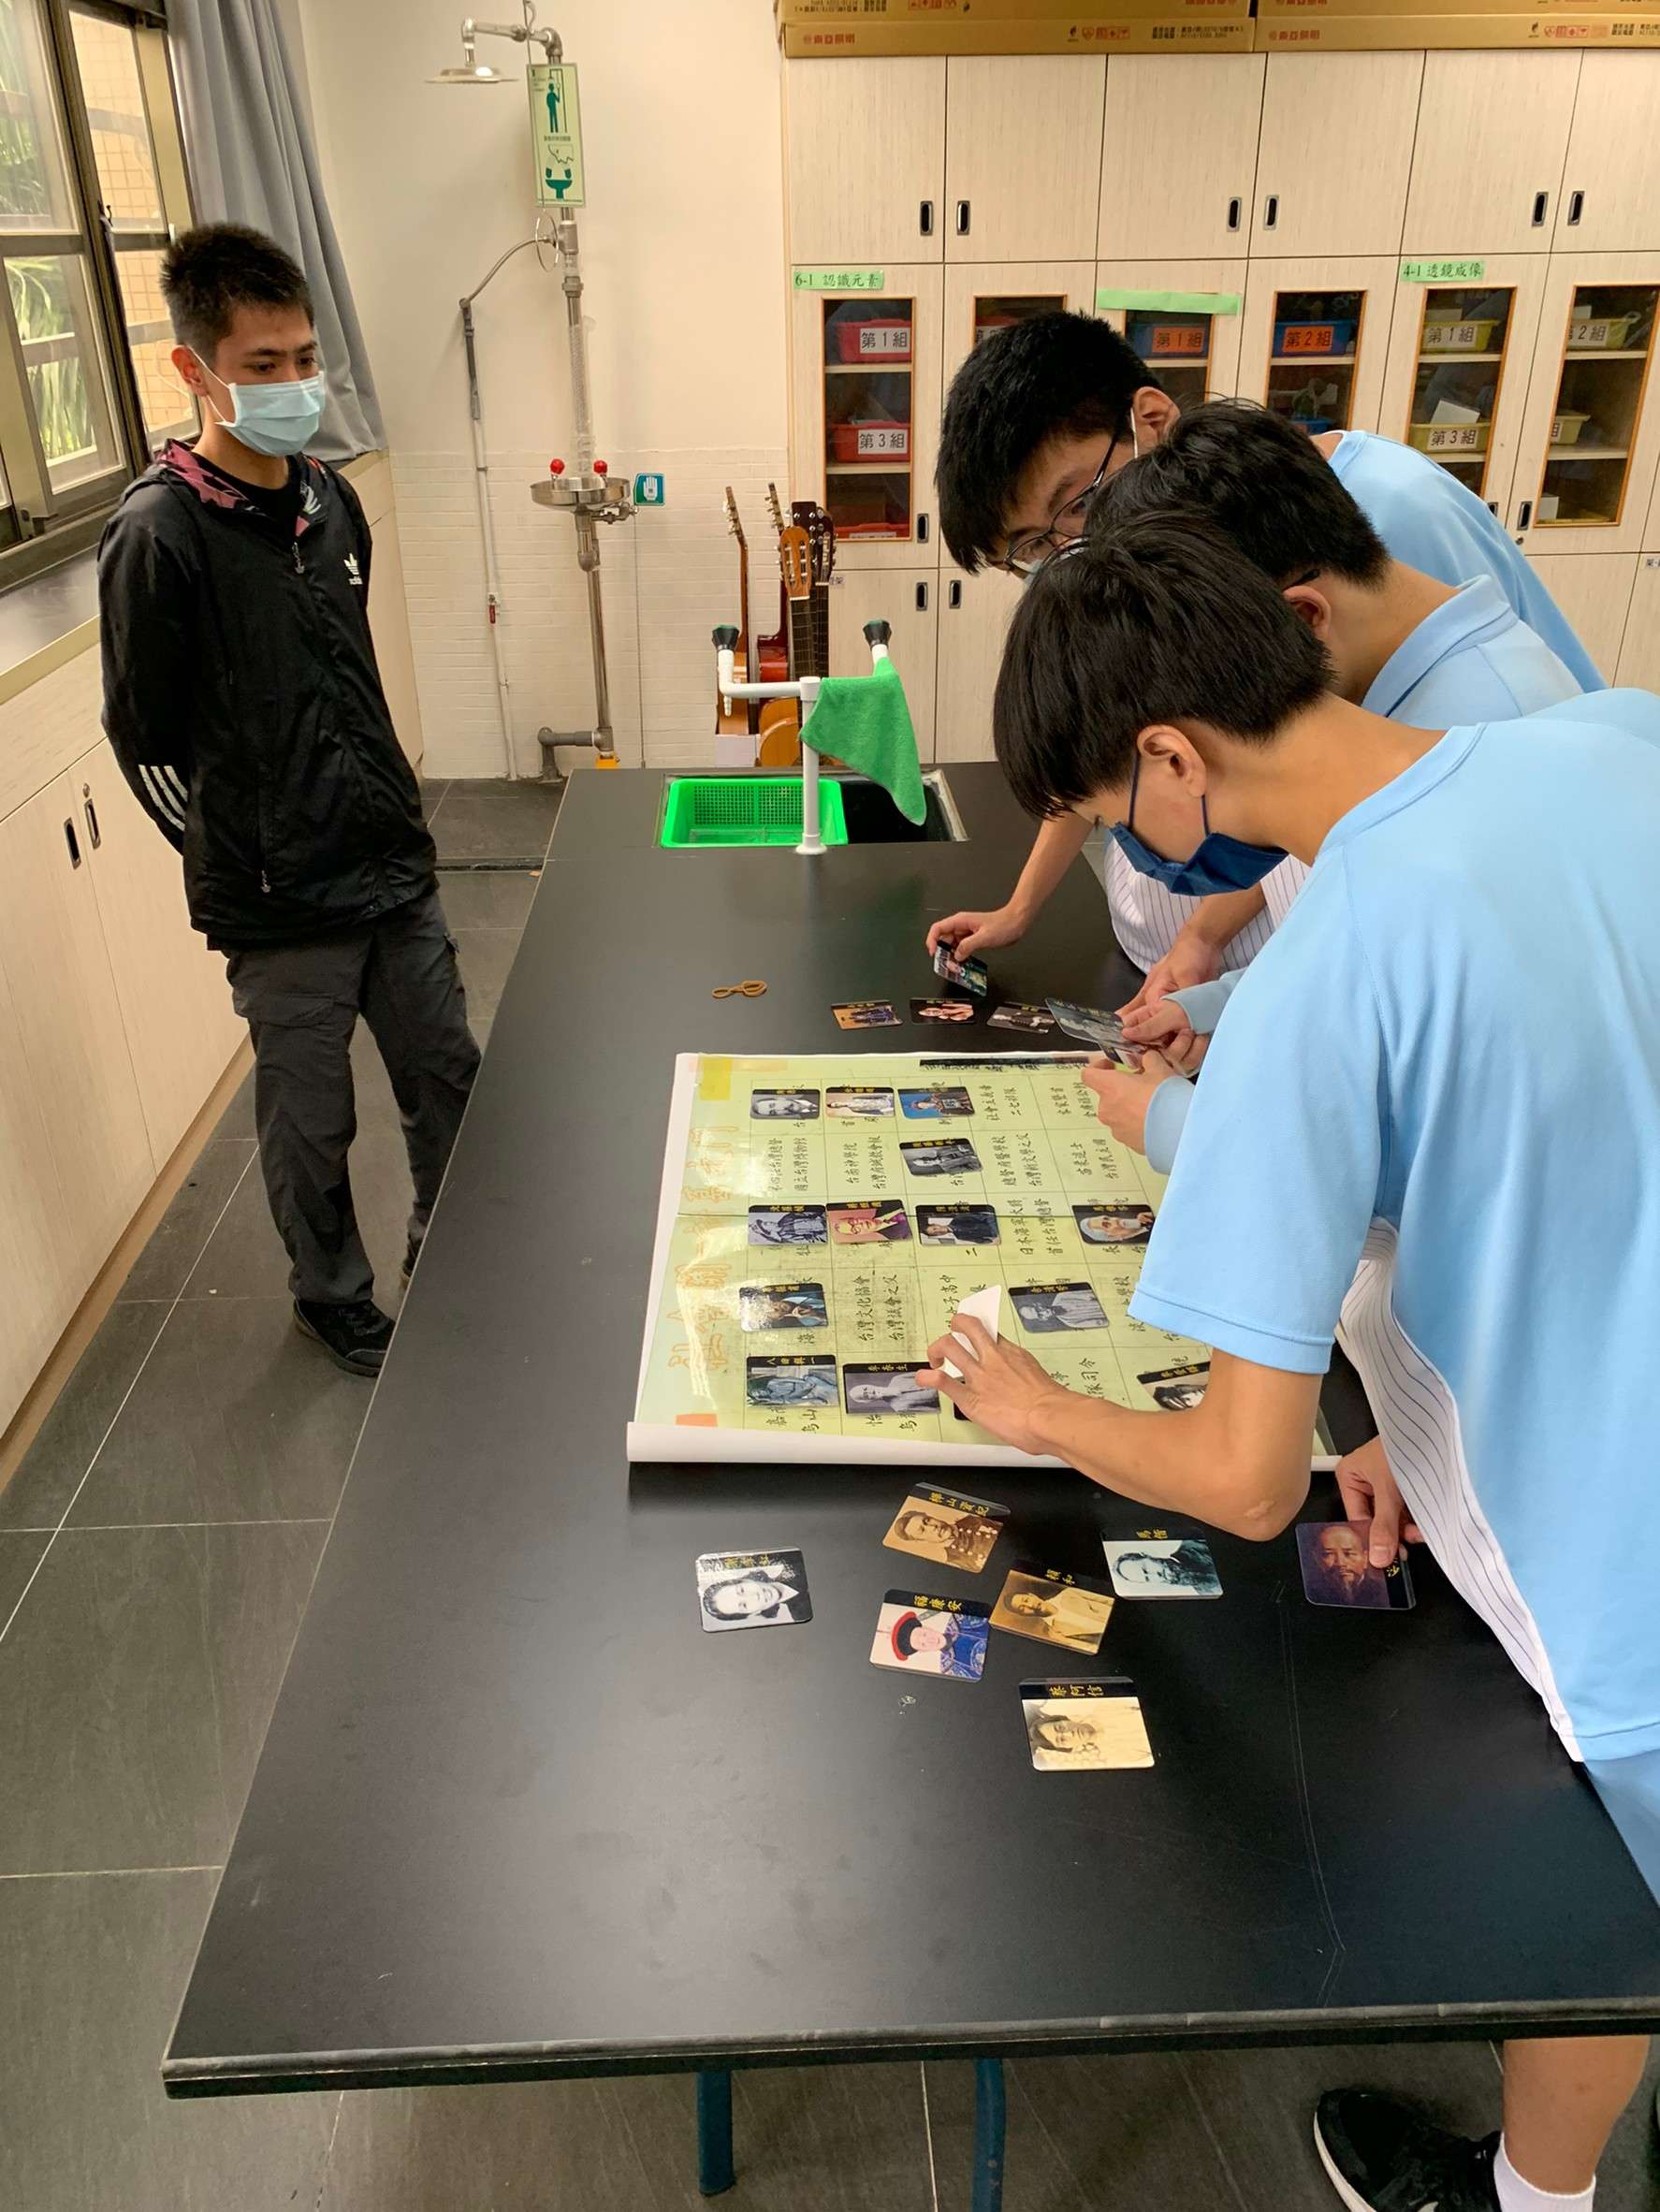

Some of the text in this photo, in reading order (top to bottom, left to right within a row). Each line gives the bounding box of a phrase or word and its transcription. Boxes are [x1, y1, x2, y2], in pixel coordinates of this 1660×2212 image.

[1426, 262, 1482, 278] 透鏡成像
[794, 273, 880, 288] 6-1 認識元素
[861, 331, 908, 349] 第1組
[1156, 332, 1203, 349] 第1組
[1285, 329, 1332, 347] 第2組
[1427, 327, 1475, 344] 第1組
[859, 433, 906, 449] 第3組
[1430, 429, 1478, 446] 第3組
[852, 1274, 875, 1341] 台灣文化協會
[882, 1273, 905, 1341] 台灣議會之父
[912, 1593, 964, 1612] 福康安
[1047, 1682, 1104, 1698] 蔡阿信
